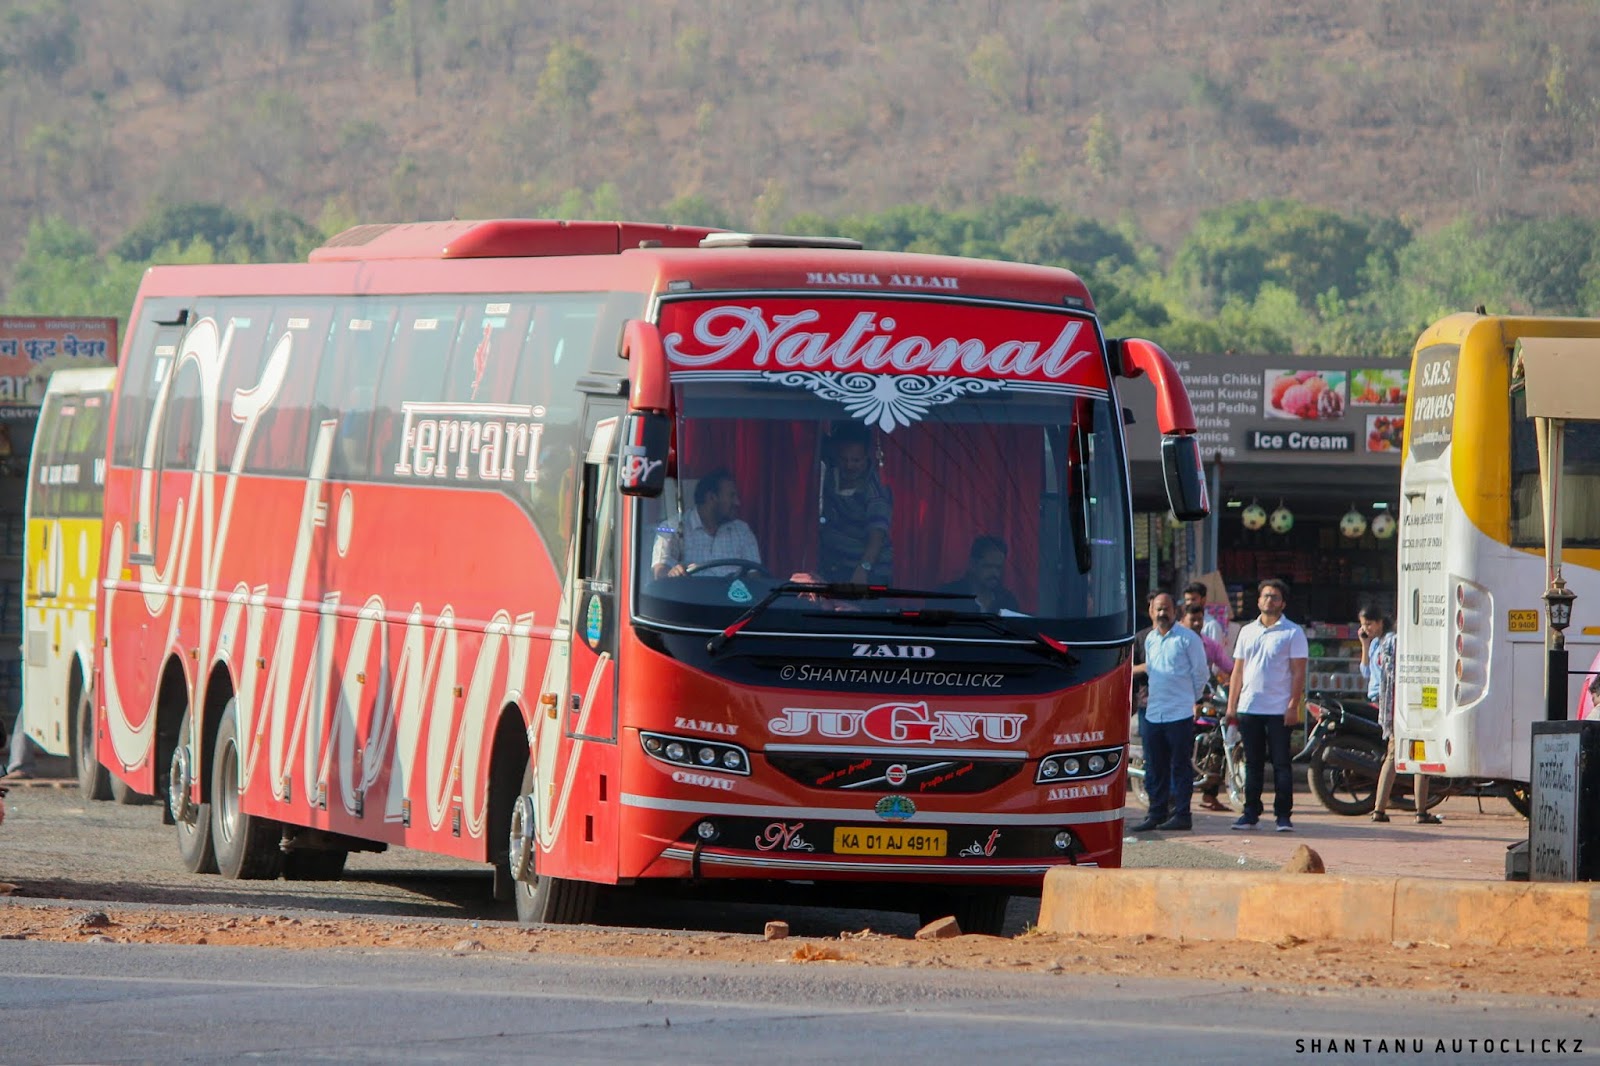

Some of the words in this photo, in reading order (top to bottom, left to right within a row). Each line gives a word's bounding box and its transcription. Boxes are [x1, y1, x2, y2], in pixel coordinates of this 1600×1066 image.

[806, 272, 881, 285] MASHA
[888, 274, 959, 289] ALLAH
[663, 305, 1092, 379] National
[1222, 373, 1262, 385] Chikki
[1422, 360, 1451, 387] S.R.S.
[1188, 389, 1214, 398] aum
[1218, 388, 1258, 399] Kunda
[1218, 402, 1257, 414] Pedha
[1414, 393, 1455, 421] travels
[394, 401, 546, 482] Ferrari
[1198, 431, 1229, 442] onics
[1254, 431, 1283, 448] Ice
[1288, 431, 1348, 449] Cream
[104, 316, 619, 855] National
[1526, 612, 1536, 620] 51
[852, 643, 936, 659] ZAID
[674, 716, 739, 735] ZAMAN
[767, 701, 1028, 744] JUGNU
[672, 771, 736, 791] CHOTU
[842, 834, 859, 848] KA
[866, 834, 882, 849] 01
[886, 835, 902, 850] AJ
[907, 836, 939, 850] 4911
